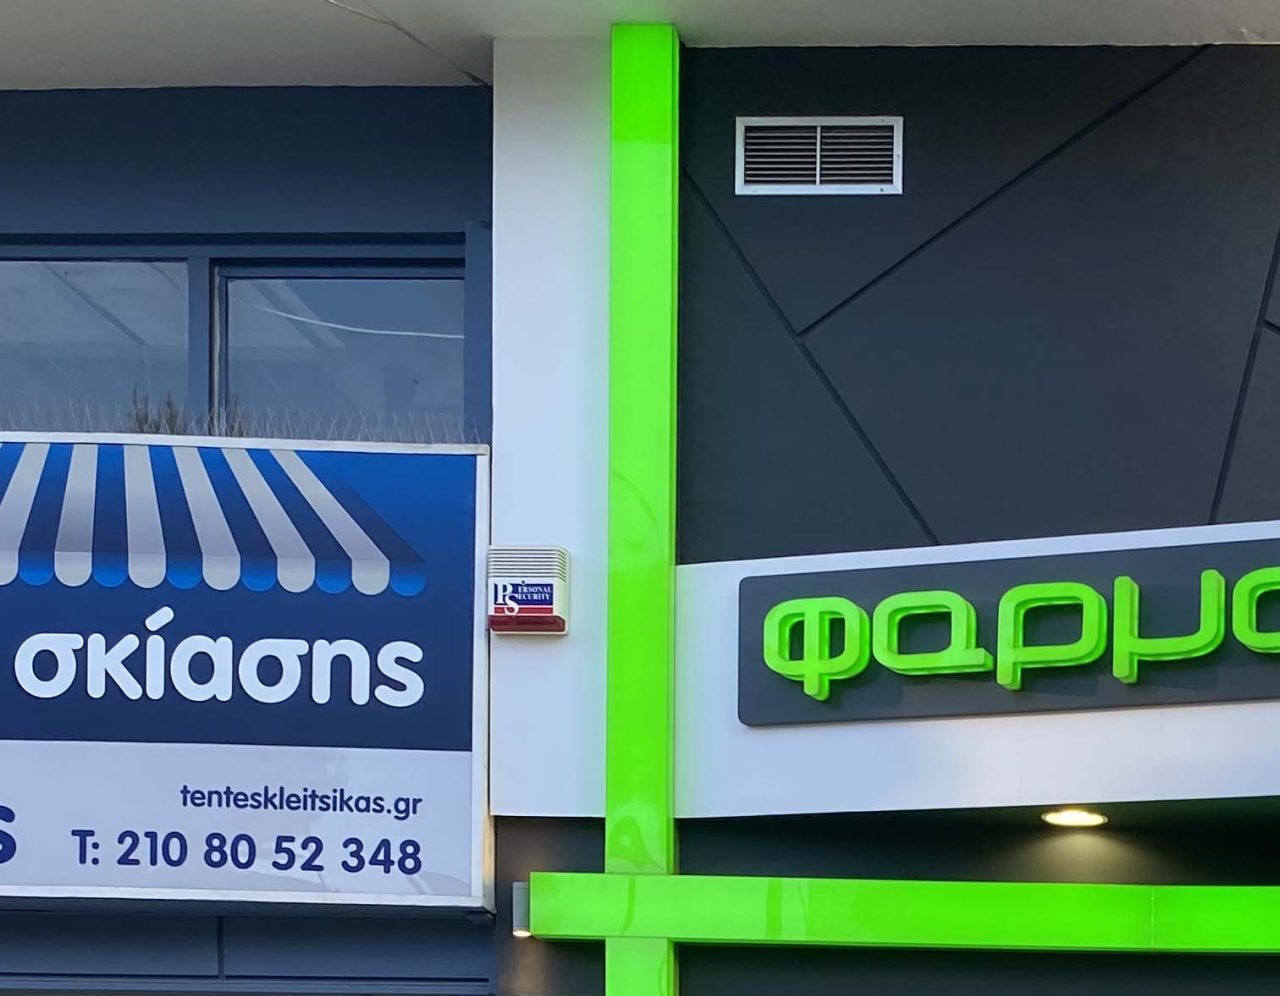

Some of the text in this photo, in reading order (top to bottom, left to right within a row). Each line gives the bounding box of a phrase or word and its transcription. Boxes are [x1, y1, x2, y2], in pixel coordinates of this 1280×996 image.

[180, 784, 422, 821] tenteskleitsikas.gr
[71, 830, 422, 875] T: 210 80 52 348
